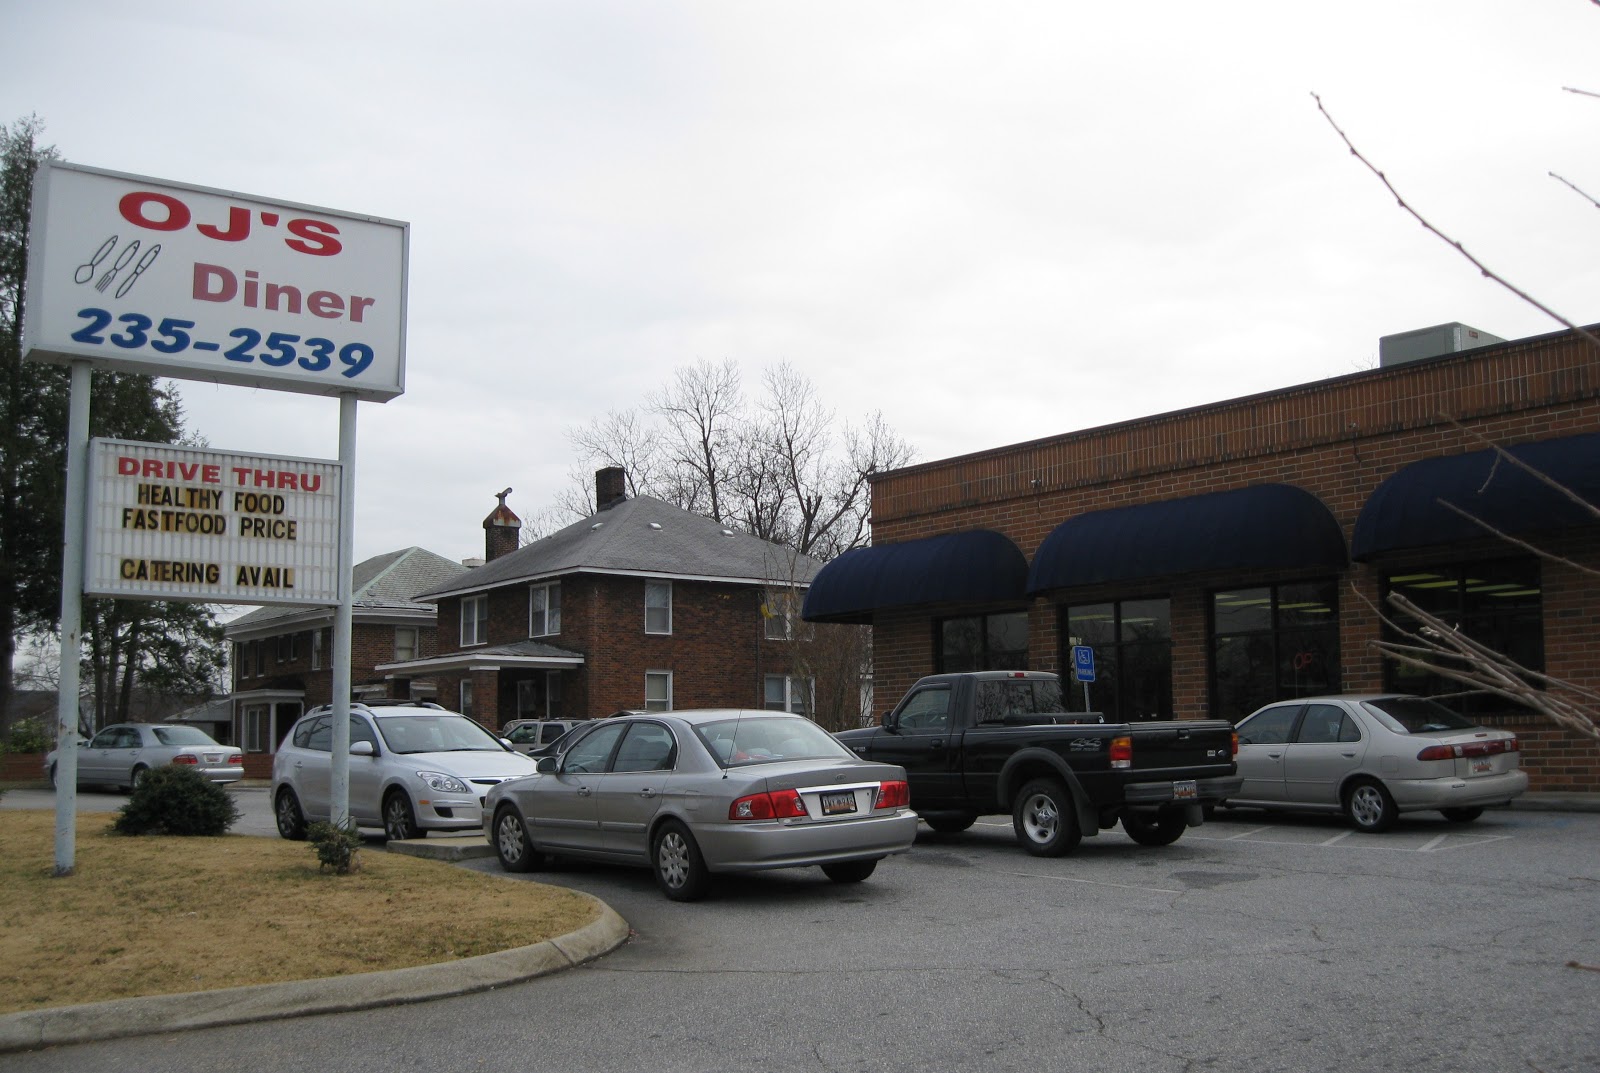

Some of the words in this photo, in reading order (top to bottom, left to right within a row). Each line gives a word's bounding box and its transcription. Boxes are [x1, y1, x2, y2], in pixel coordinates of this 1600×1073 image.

[119, 191, 343, 256] OJ'S
[192, 262, 376, 322] Diner
[71, 308, 374, 378] 235-2539
[118, 457, 221, 483] DRIVE
[232, 467, 321, 492] THRU
[138, 484, 223, 509] HEALTHY
[234, 492, 285, 515] FOOD
[240, 517, 297, 540] PRICE
[120, 559, 220, 584] CATERING
[236, 566, 294, 588] AVAIL
